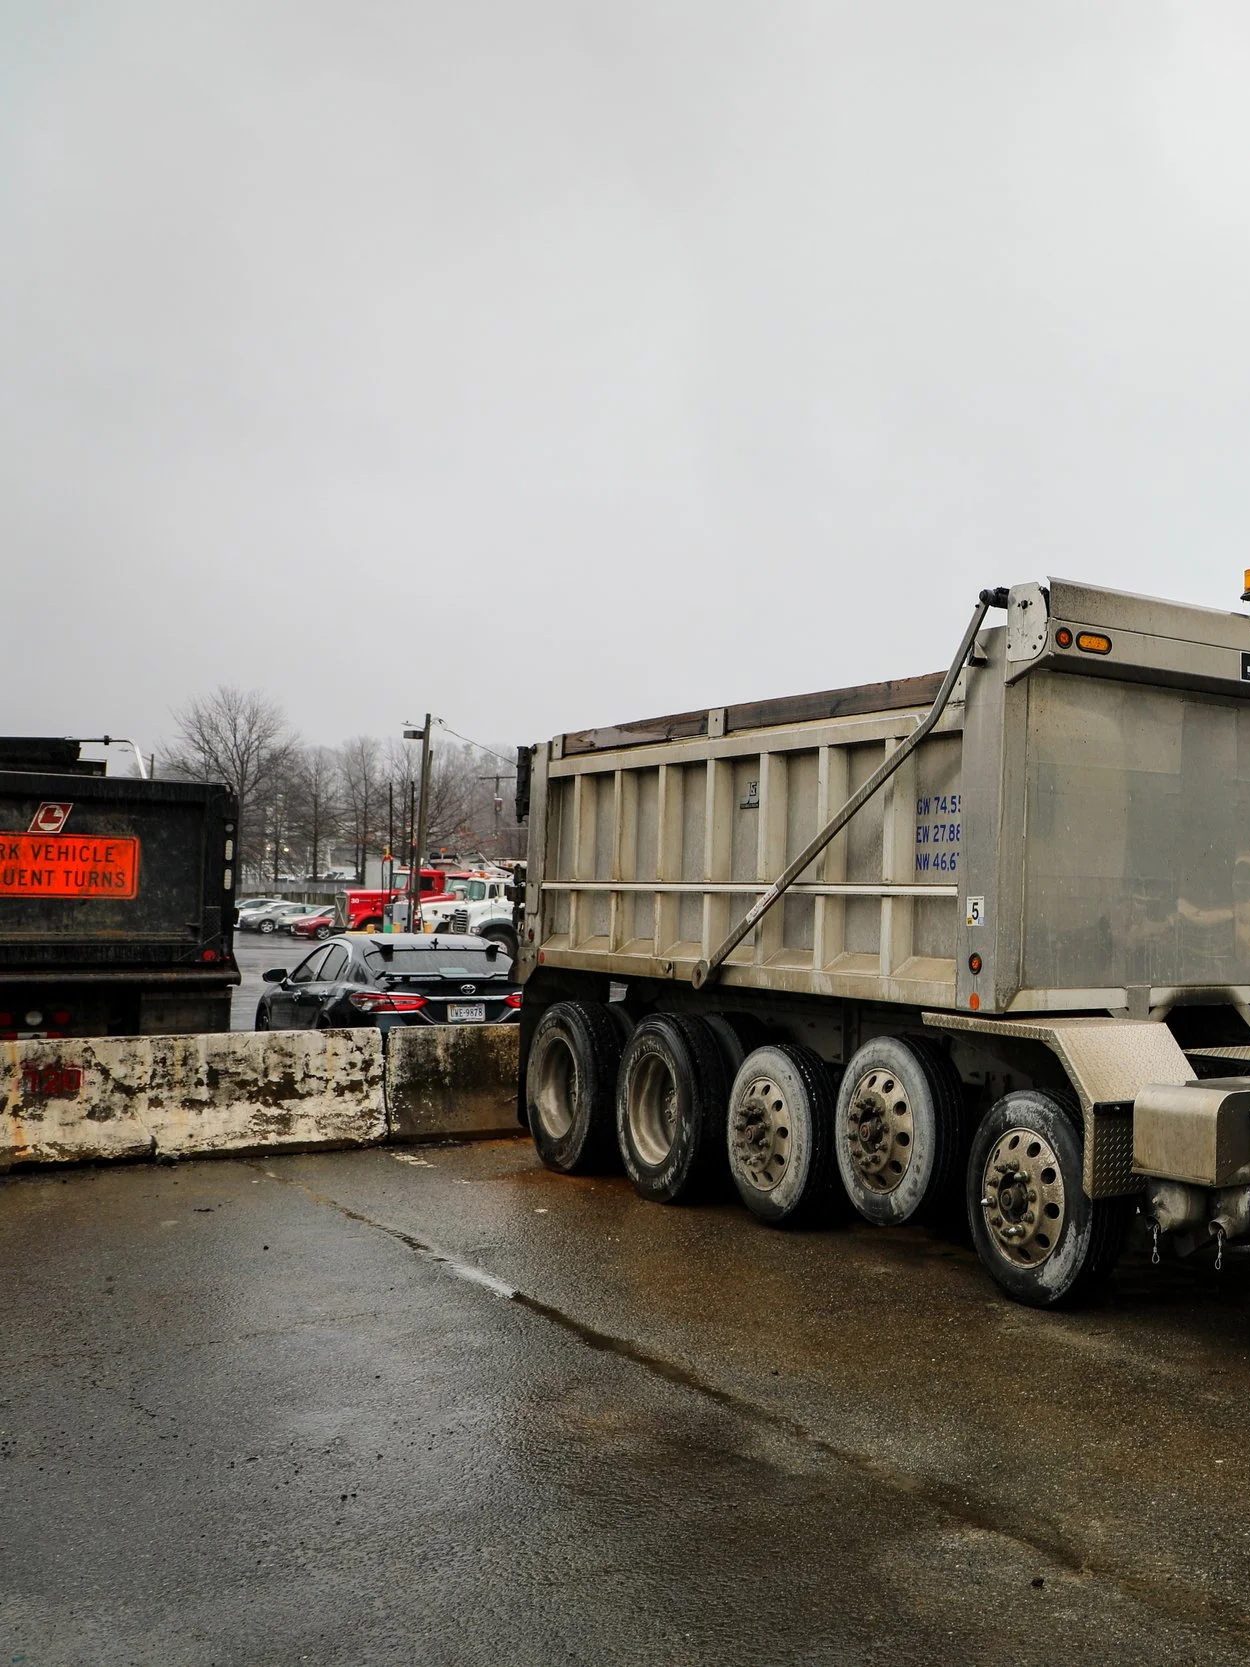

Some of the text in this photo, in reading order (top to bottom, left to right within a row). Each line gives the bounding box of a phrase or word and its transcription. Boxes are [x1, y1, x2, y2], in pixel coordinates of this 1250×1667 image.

[917, 797, 931, 815] GW
[917, 825, 930, 843] EW
[31, 844, 115, 863] VEHICLE
[916, 853, 930, 871] NW
[64, 870, 126, 888] TURNS
[972, 902, 979, 920] 5
